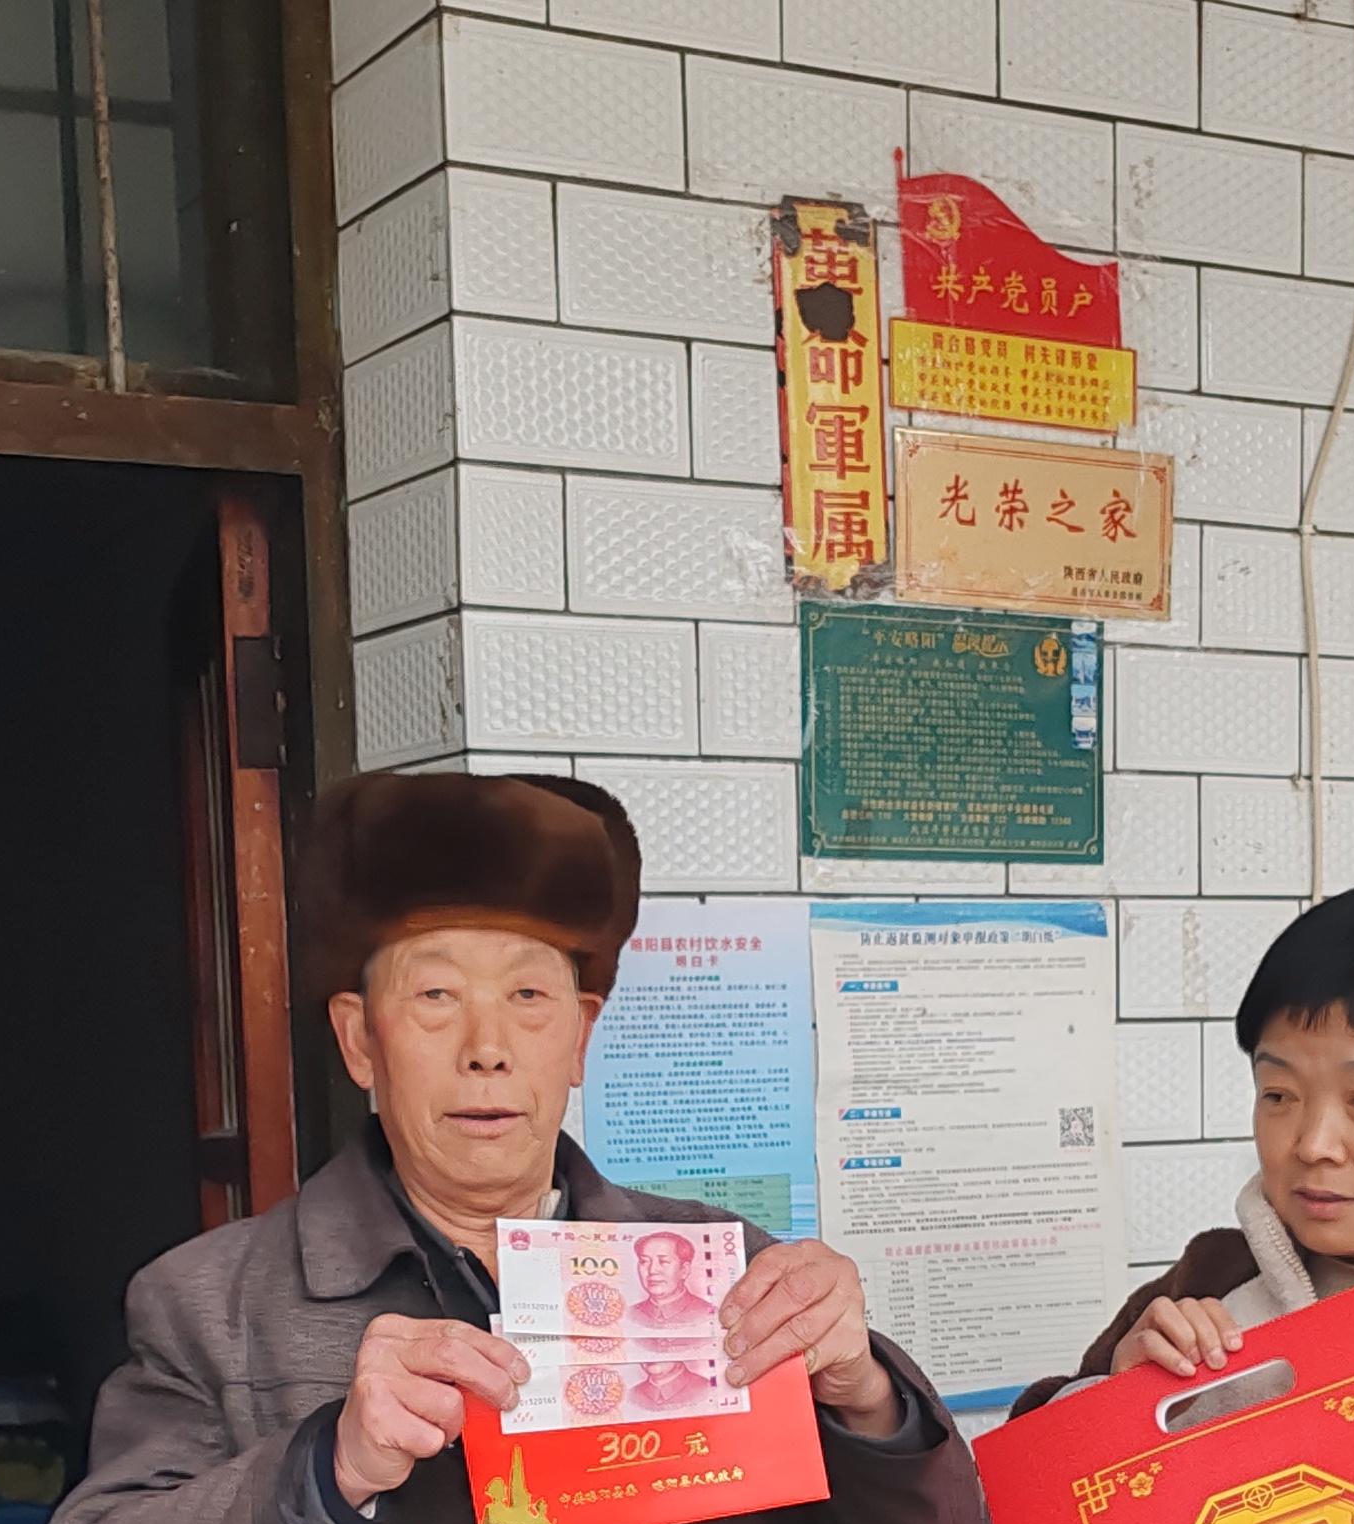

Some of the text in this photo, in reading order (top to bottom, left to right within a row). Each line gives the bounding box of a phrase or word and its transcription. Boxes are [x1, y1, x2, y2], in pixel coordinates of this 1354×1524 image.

[932, 266, 1094, 318] 共产党员户
[938, 473, 1138, 544] 光荣之家
[570, 1257, 619, 1277] 100
[597, 1430, 710, 1464] 300 元
